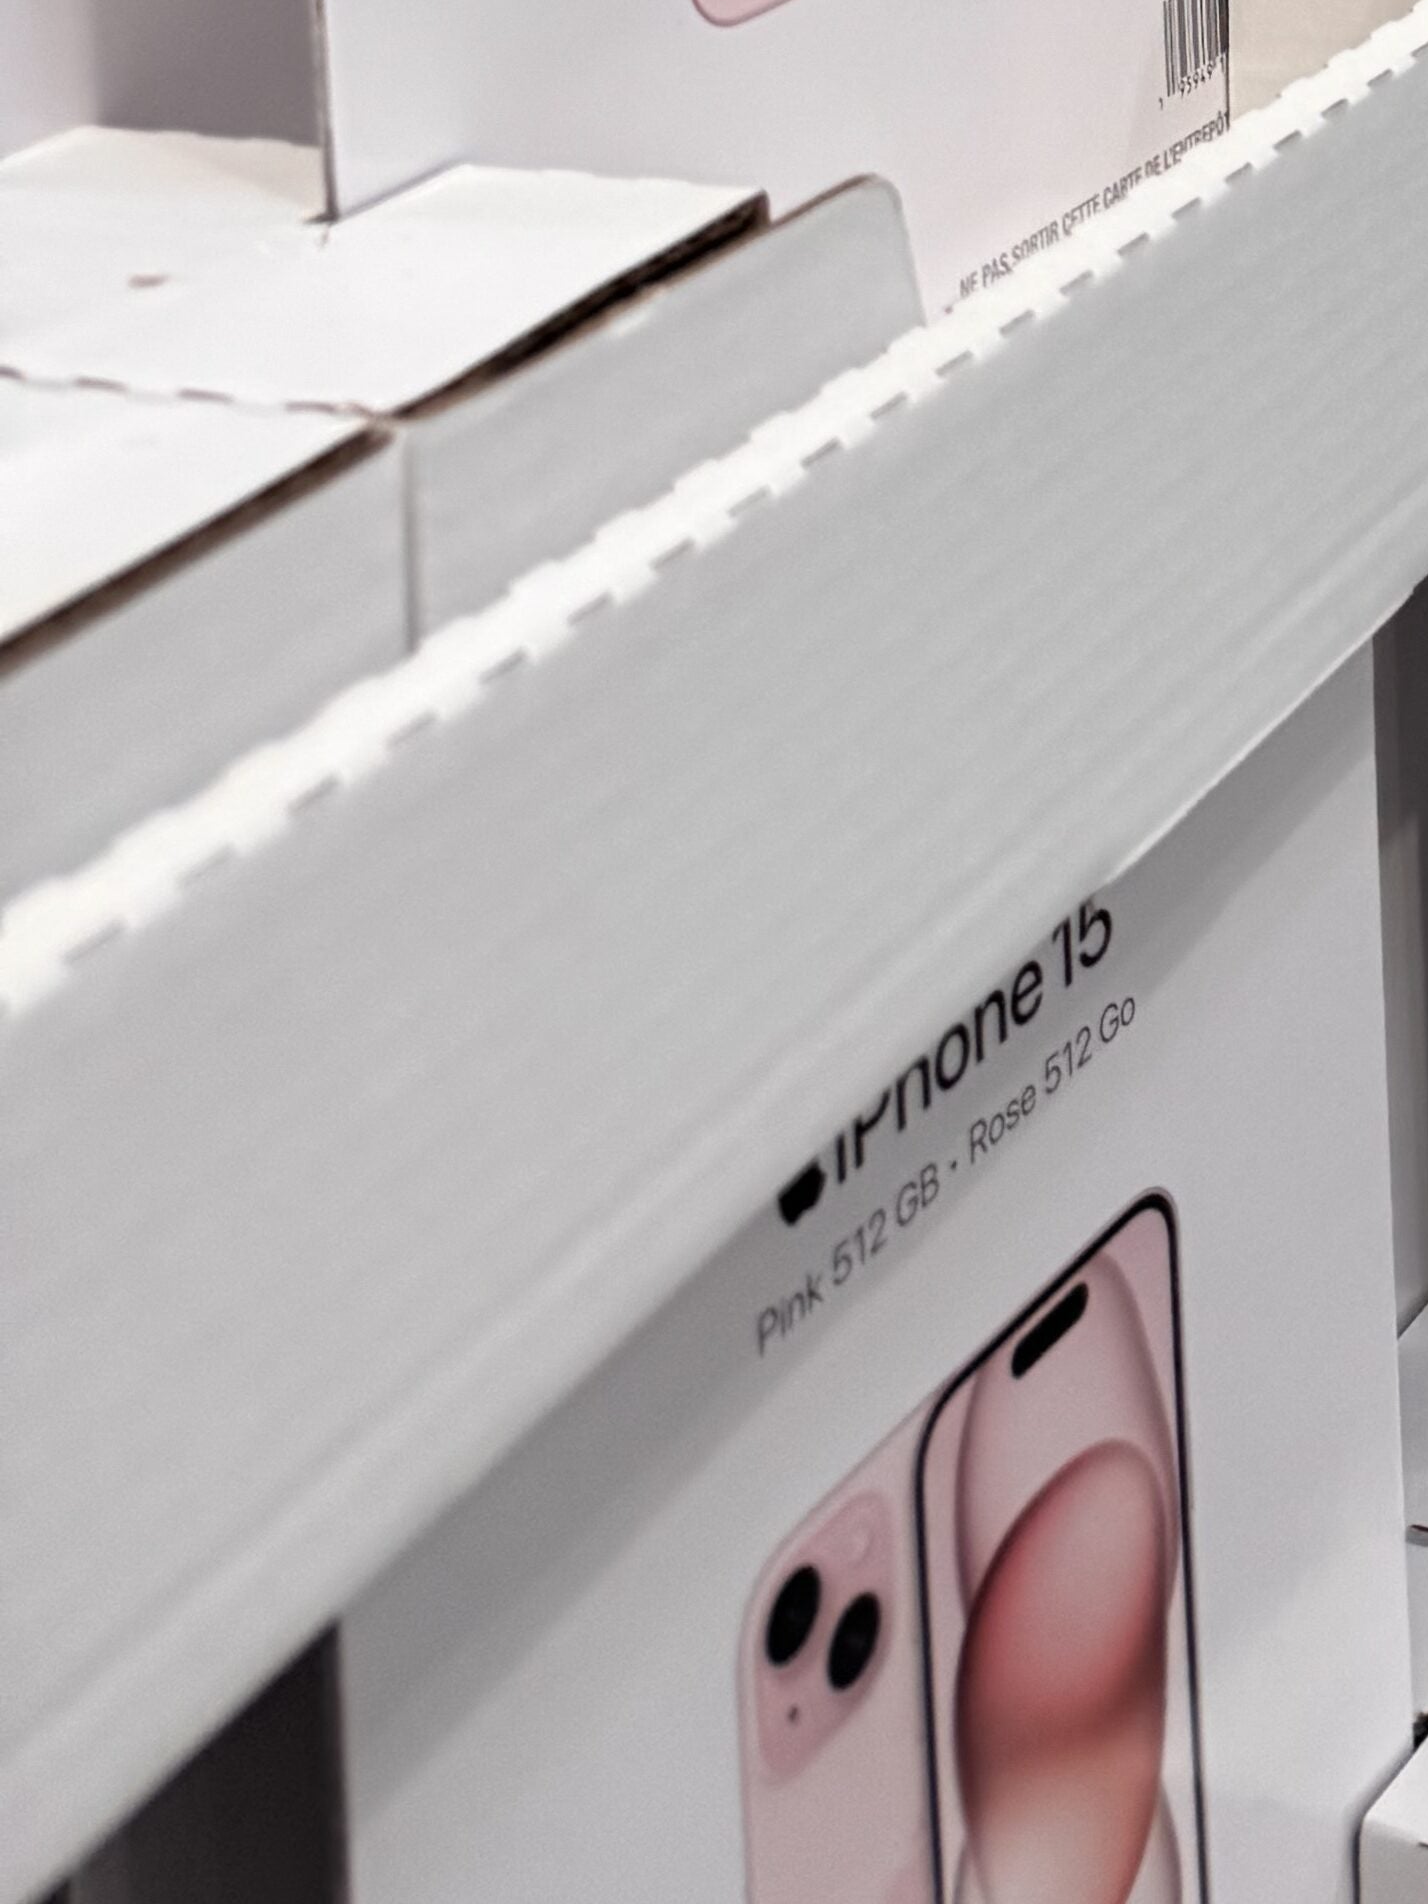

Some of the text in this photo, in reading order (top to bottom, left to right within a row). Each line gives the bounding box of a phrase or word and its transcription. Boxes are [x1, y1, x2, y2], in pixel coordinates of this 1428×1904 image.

[981, 254, 1012, 289] PAS
[1011, 220, 1060, 266] SORTIR
[1062, 194, 1101, 238] CETTE
[1103, 166, 1143, 211] CARTE
[1051, 897, 1113, 988] 15
[756, 995, 1136, 1358] Pink 512 GB Rose 512 Go
